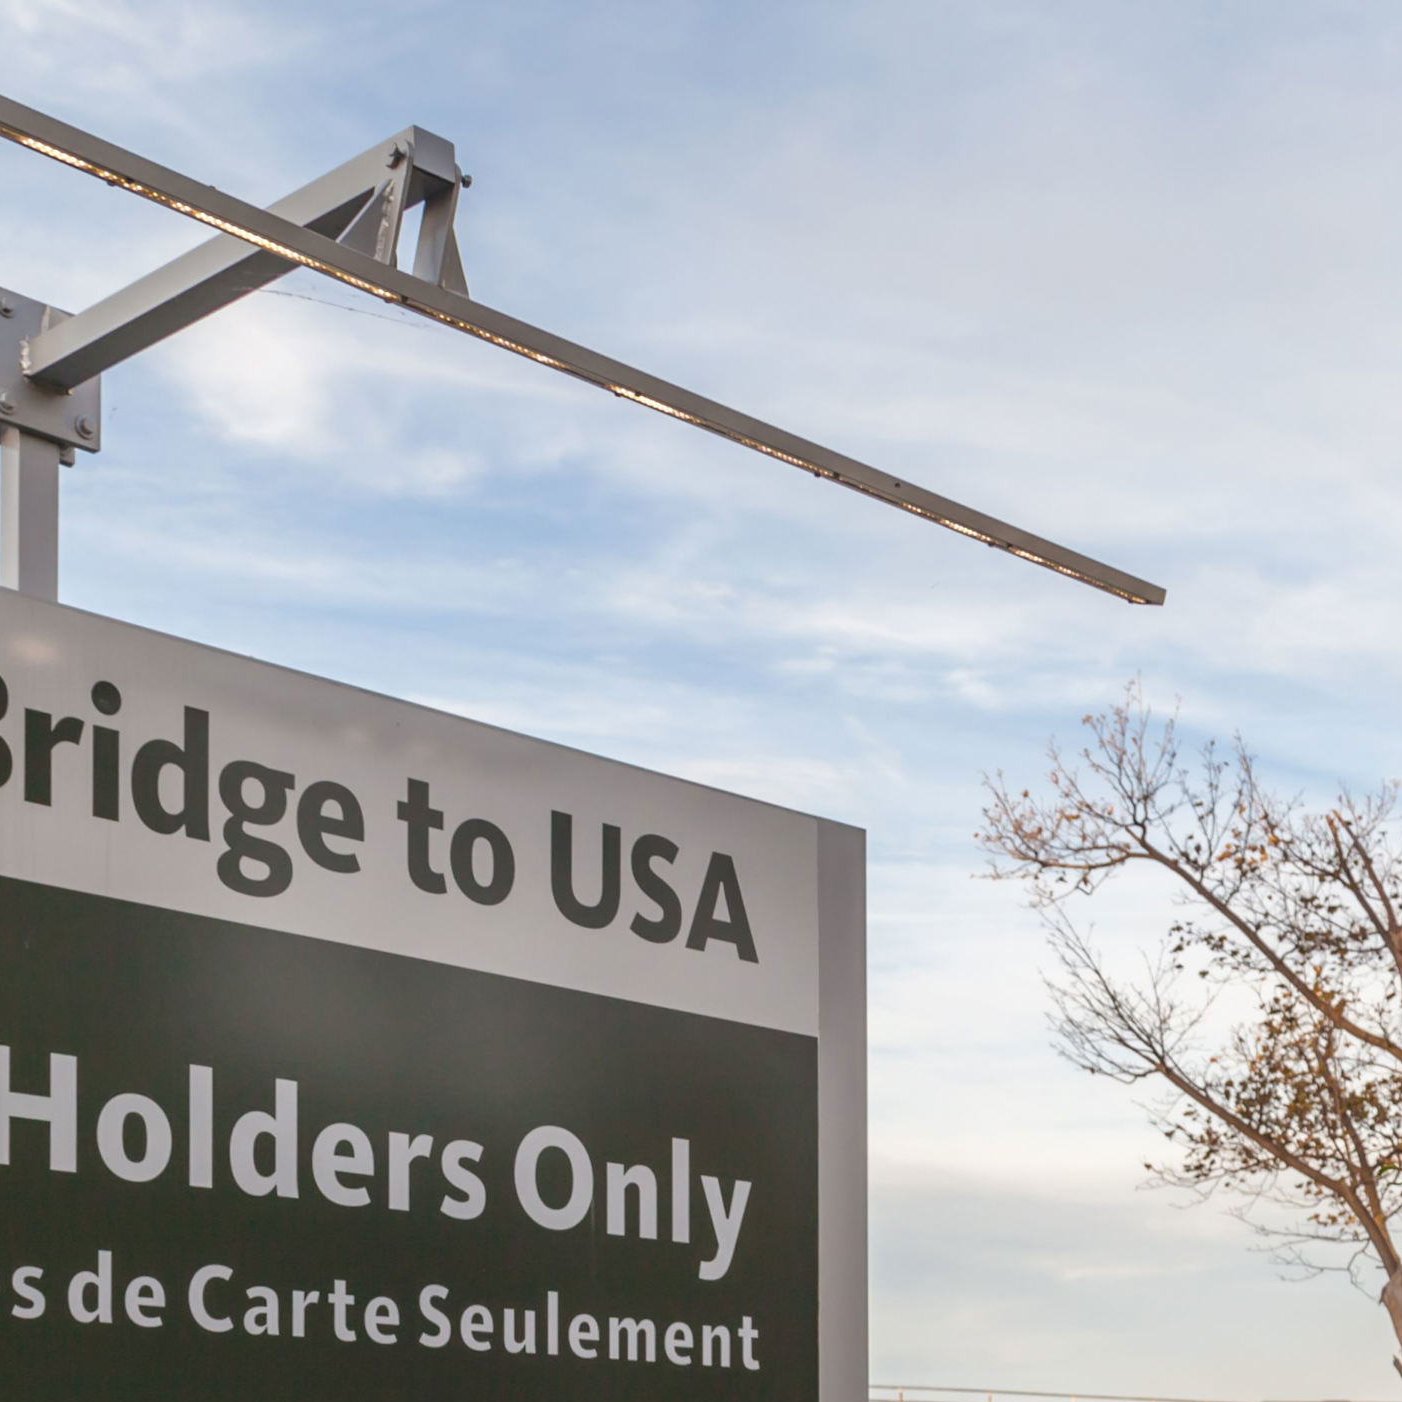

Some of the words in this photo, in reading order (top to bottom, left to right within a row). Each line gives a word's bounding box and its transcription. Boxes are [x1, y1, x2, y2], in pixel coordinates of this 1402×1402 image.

[396, 777, 516, 906] to
[550, 809, 759, 964] USA
[514, 1125, 752, 1281] Only
[68, 1250, 166, 1328] de
[188, 1264, 400, 1344] Carte
[419, 1284, 760, 1370] Seulement
